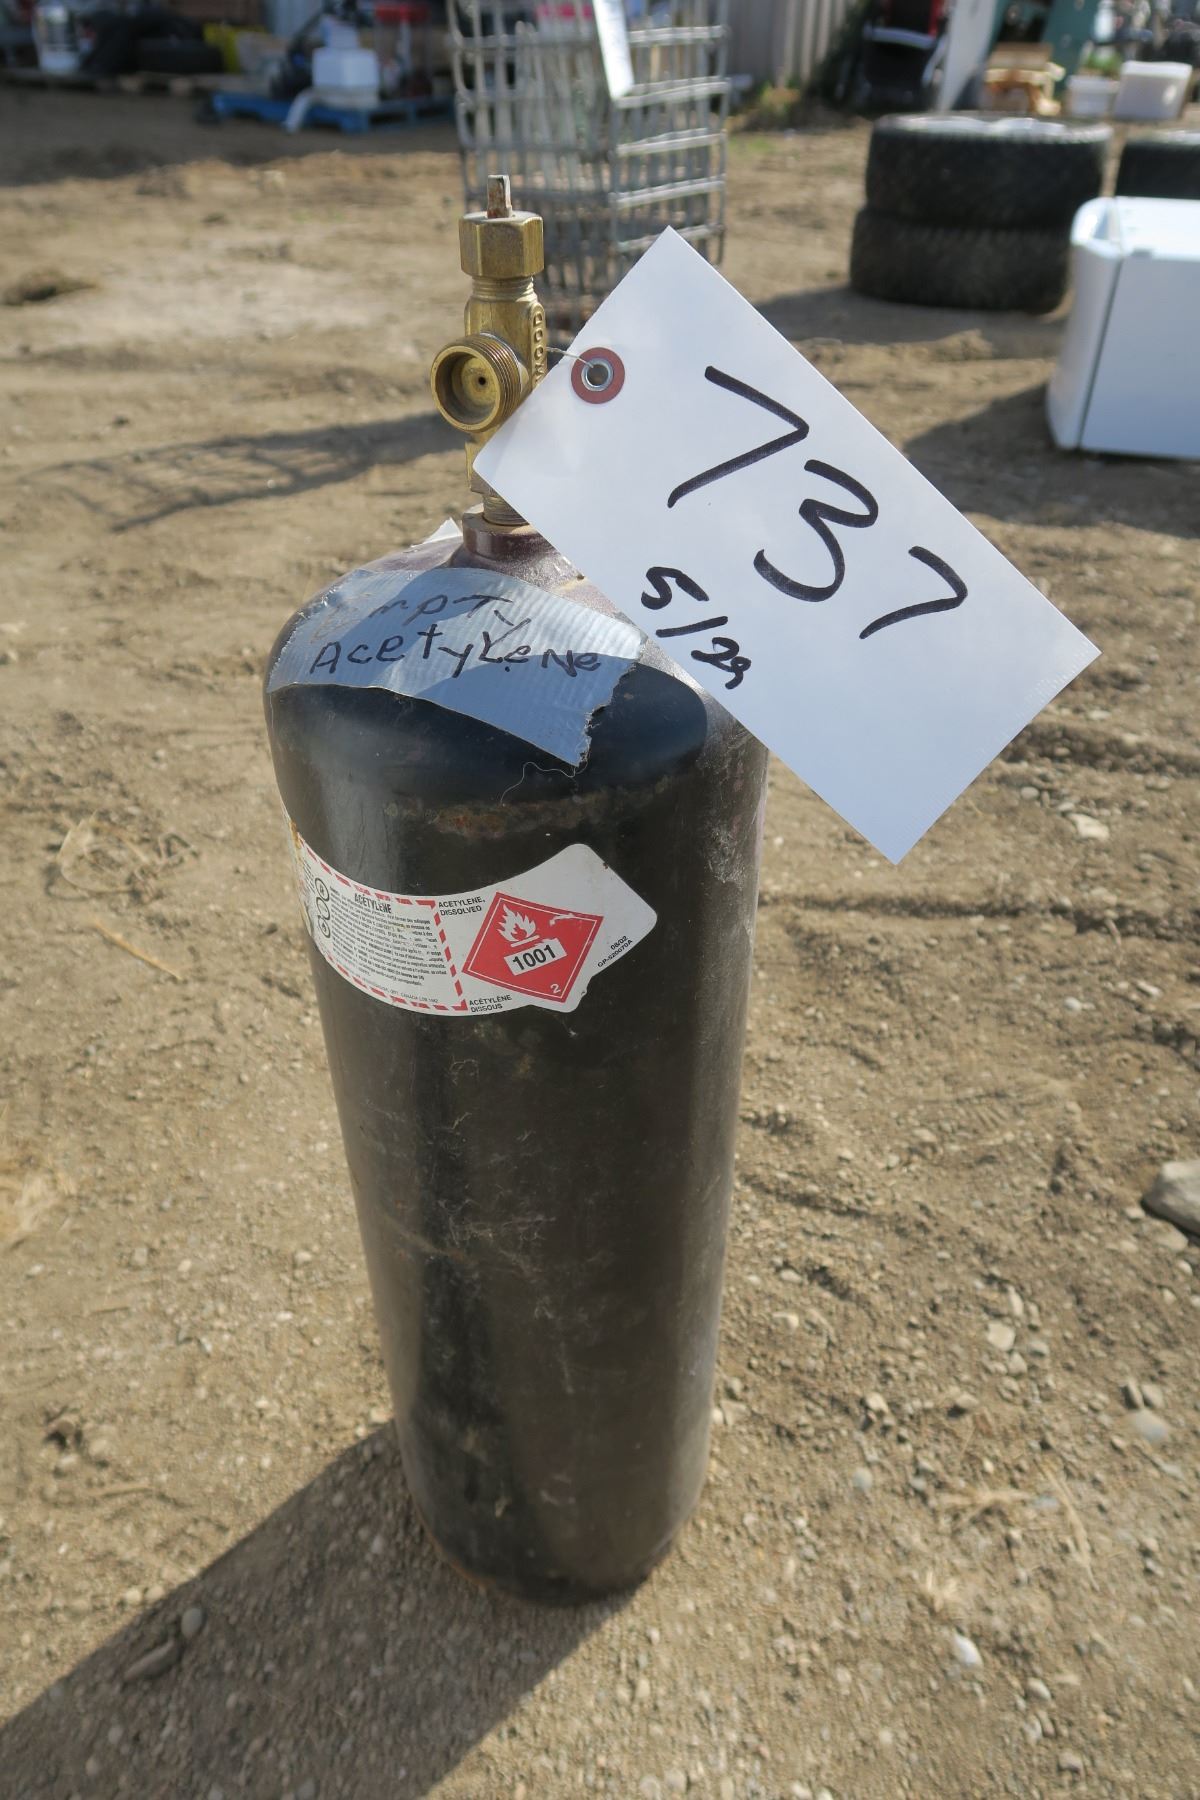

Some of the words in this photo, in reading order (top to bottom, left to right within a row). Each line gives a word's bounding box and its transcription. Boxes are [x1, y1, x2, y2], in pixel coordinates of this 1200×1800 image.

[668, 364, 968, 640] 737
[440, 906, 482, 916] DISSOLVED
[512, 945, 556, 970] 1001
[550, 983, 561, 994] 2
[470, 1003, 502, 1013] DISSOUS
